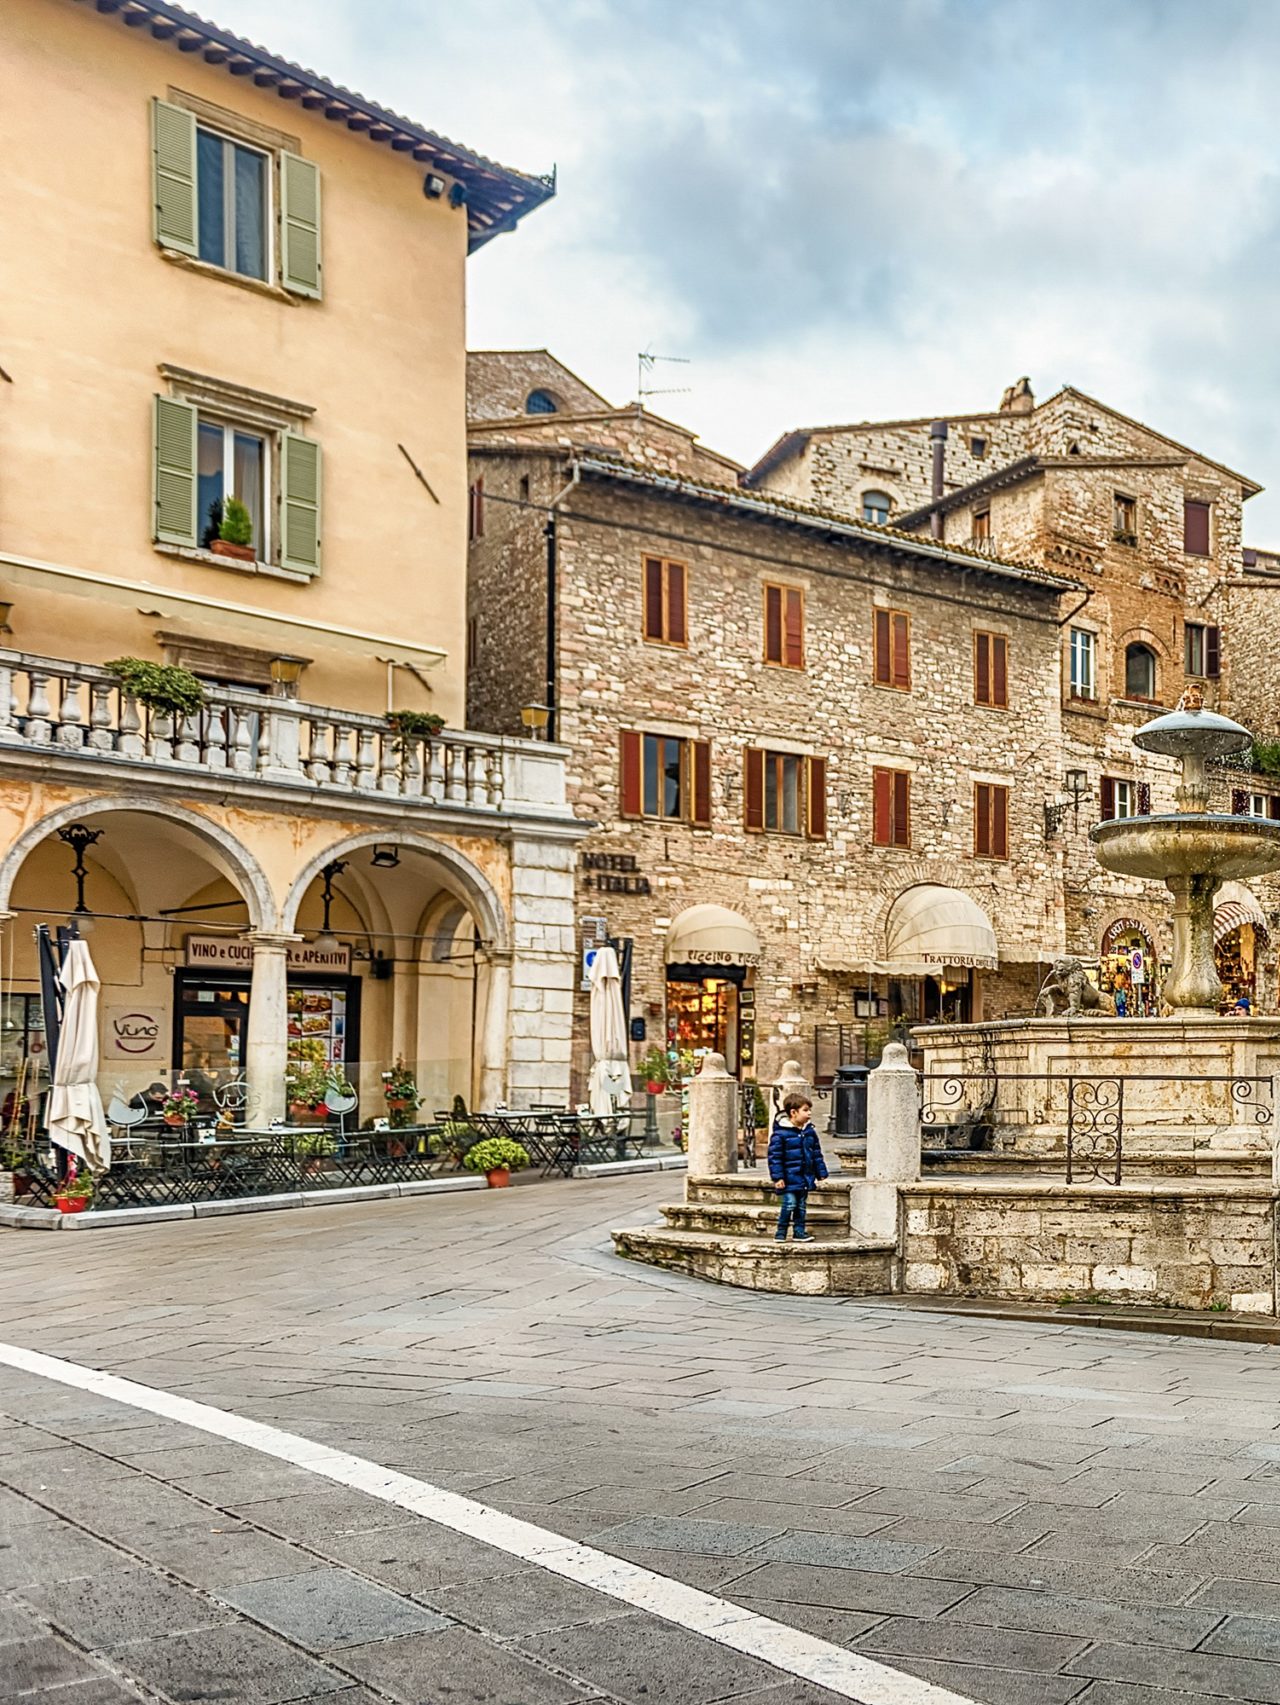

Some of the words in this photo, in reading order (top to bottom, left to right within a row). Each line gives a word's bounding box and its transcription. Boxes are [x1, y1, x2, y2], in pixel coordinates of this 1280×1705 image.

[582, 851, 641, 872] HOTEL
[192, 943, 217, 957] VINO
[220, 948, 225, 958] e
[295, 952, 300, 961] e
[303, 949, 347, 965] APERITIVI
[922, 953, 974, 966] TRATTORIA
